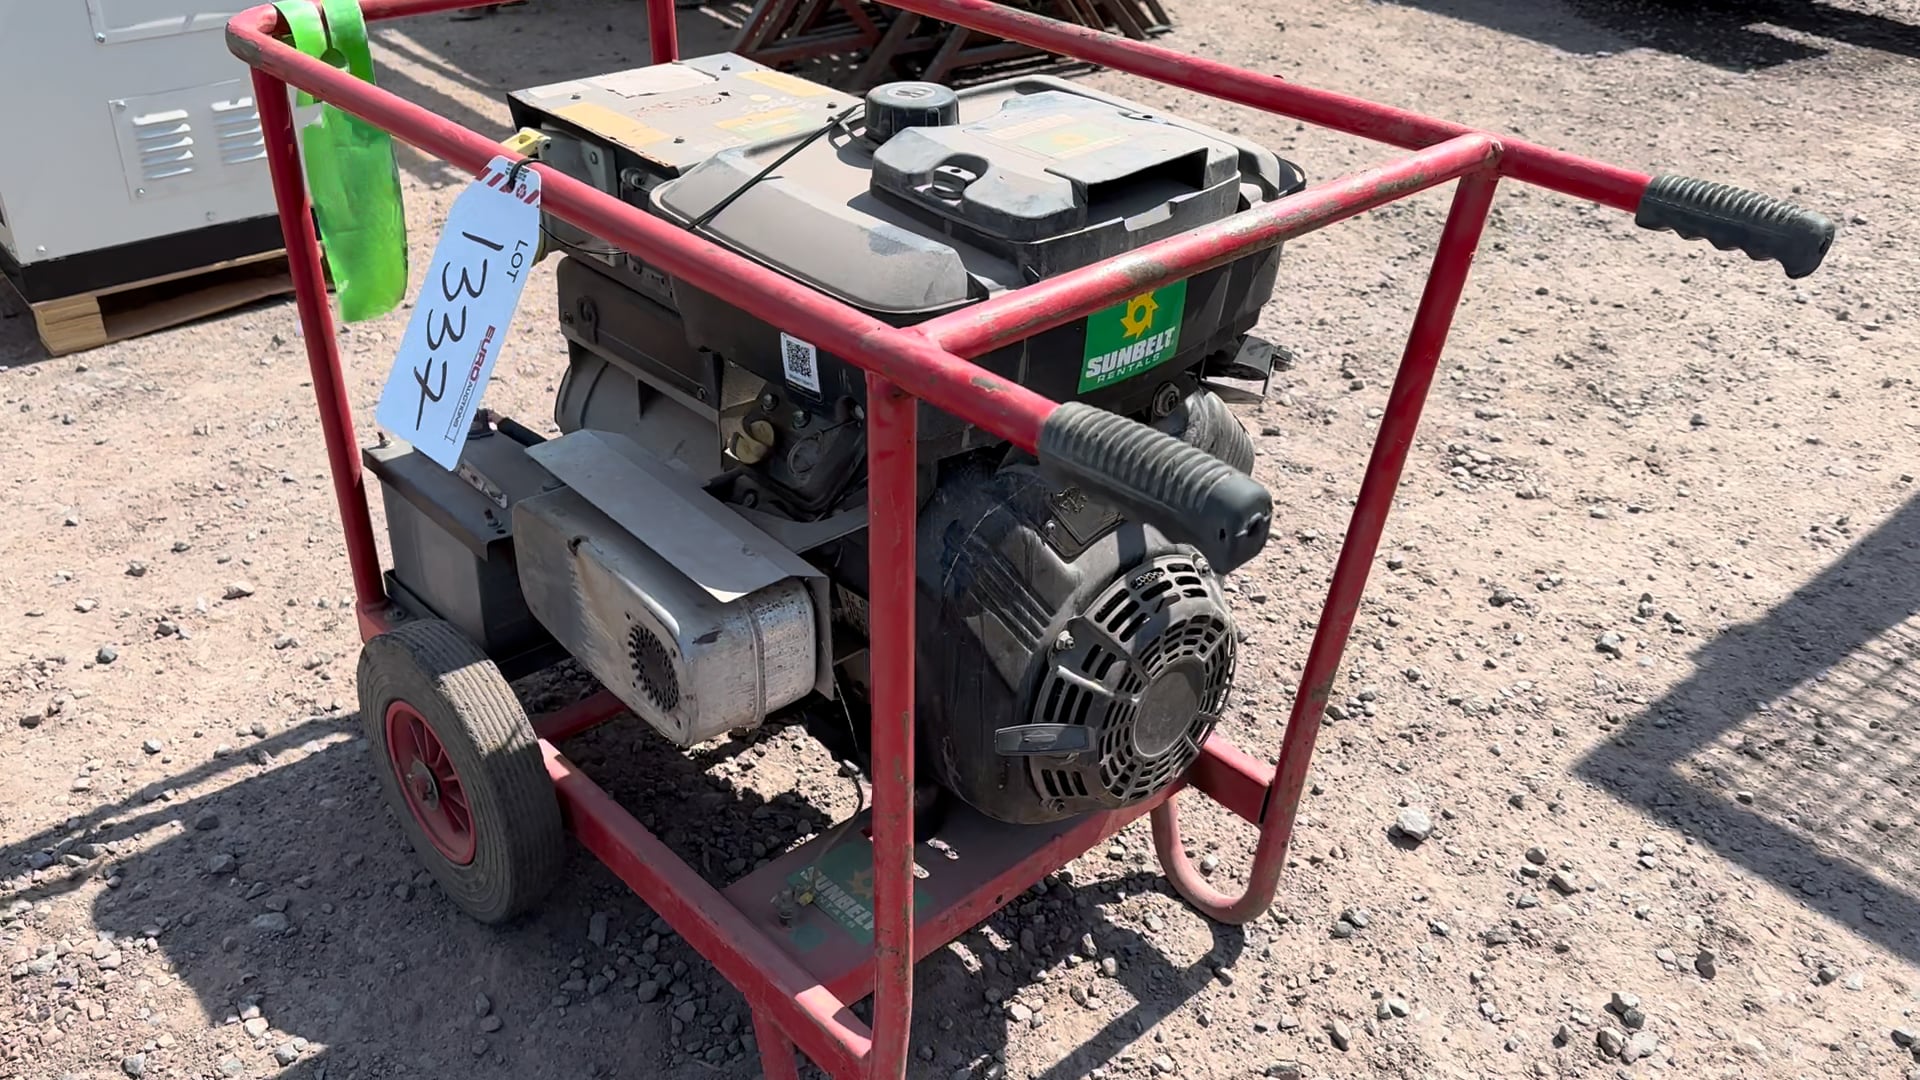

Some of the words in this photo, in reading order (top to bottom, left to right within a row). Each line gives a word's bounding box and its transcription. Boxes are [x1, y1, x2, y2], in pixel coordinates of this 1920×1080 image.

[506, 240, 528, 284] LOT
[413, 231, 504, 431] 1337
[468, 325, 496, 382] EURO
[1085, 326, 1176, 378] SUNBELT
[1097, 352, 1160, 383] RENTALS
[452, 380, 474, 429] AUCTIONS
